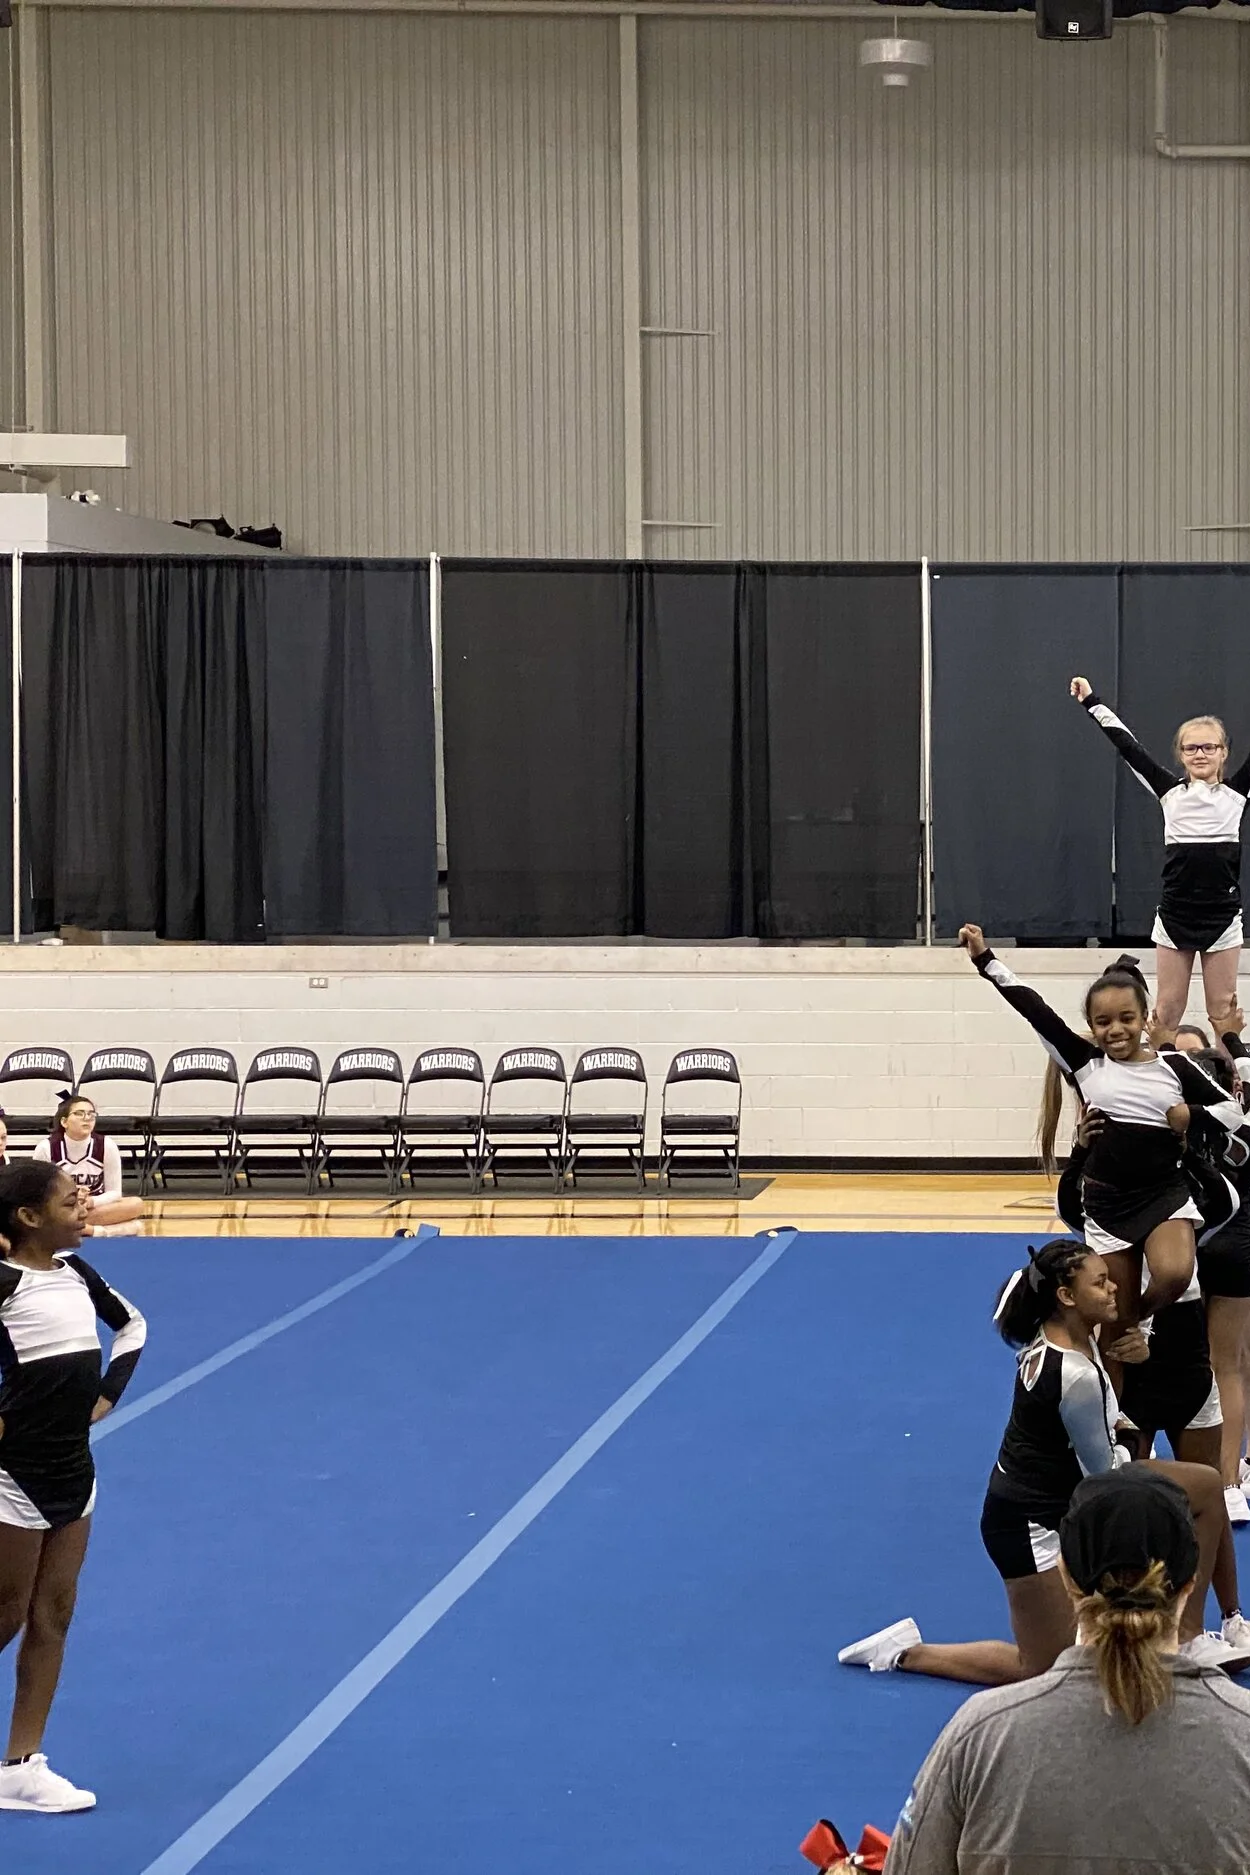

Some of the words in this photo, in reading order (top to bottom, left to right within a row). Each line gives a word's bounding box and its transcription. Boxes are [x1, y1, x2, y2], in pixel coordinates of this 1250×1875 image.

[9, 1053, 66, 1072] WARRIORS
[91, 1053, 148, 1072] WARRIORS
[173, 1053, 230, 1072] WARRIORS
[256, 1053, 313, 1071] WARRIORS
[339, 1053, 395, 1072] WARRIORS
[420, 1053, 475, 1072] WARRIORS
[503, 1053, 557, 1071] WARRIORS
[582, 1053, 637, 1071] WARRIORS
[676, 1054, 731, 1072] WARRIORS
